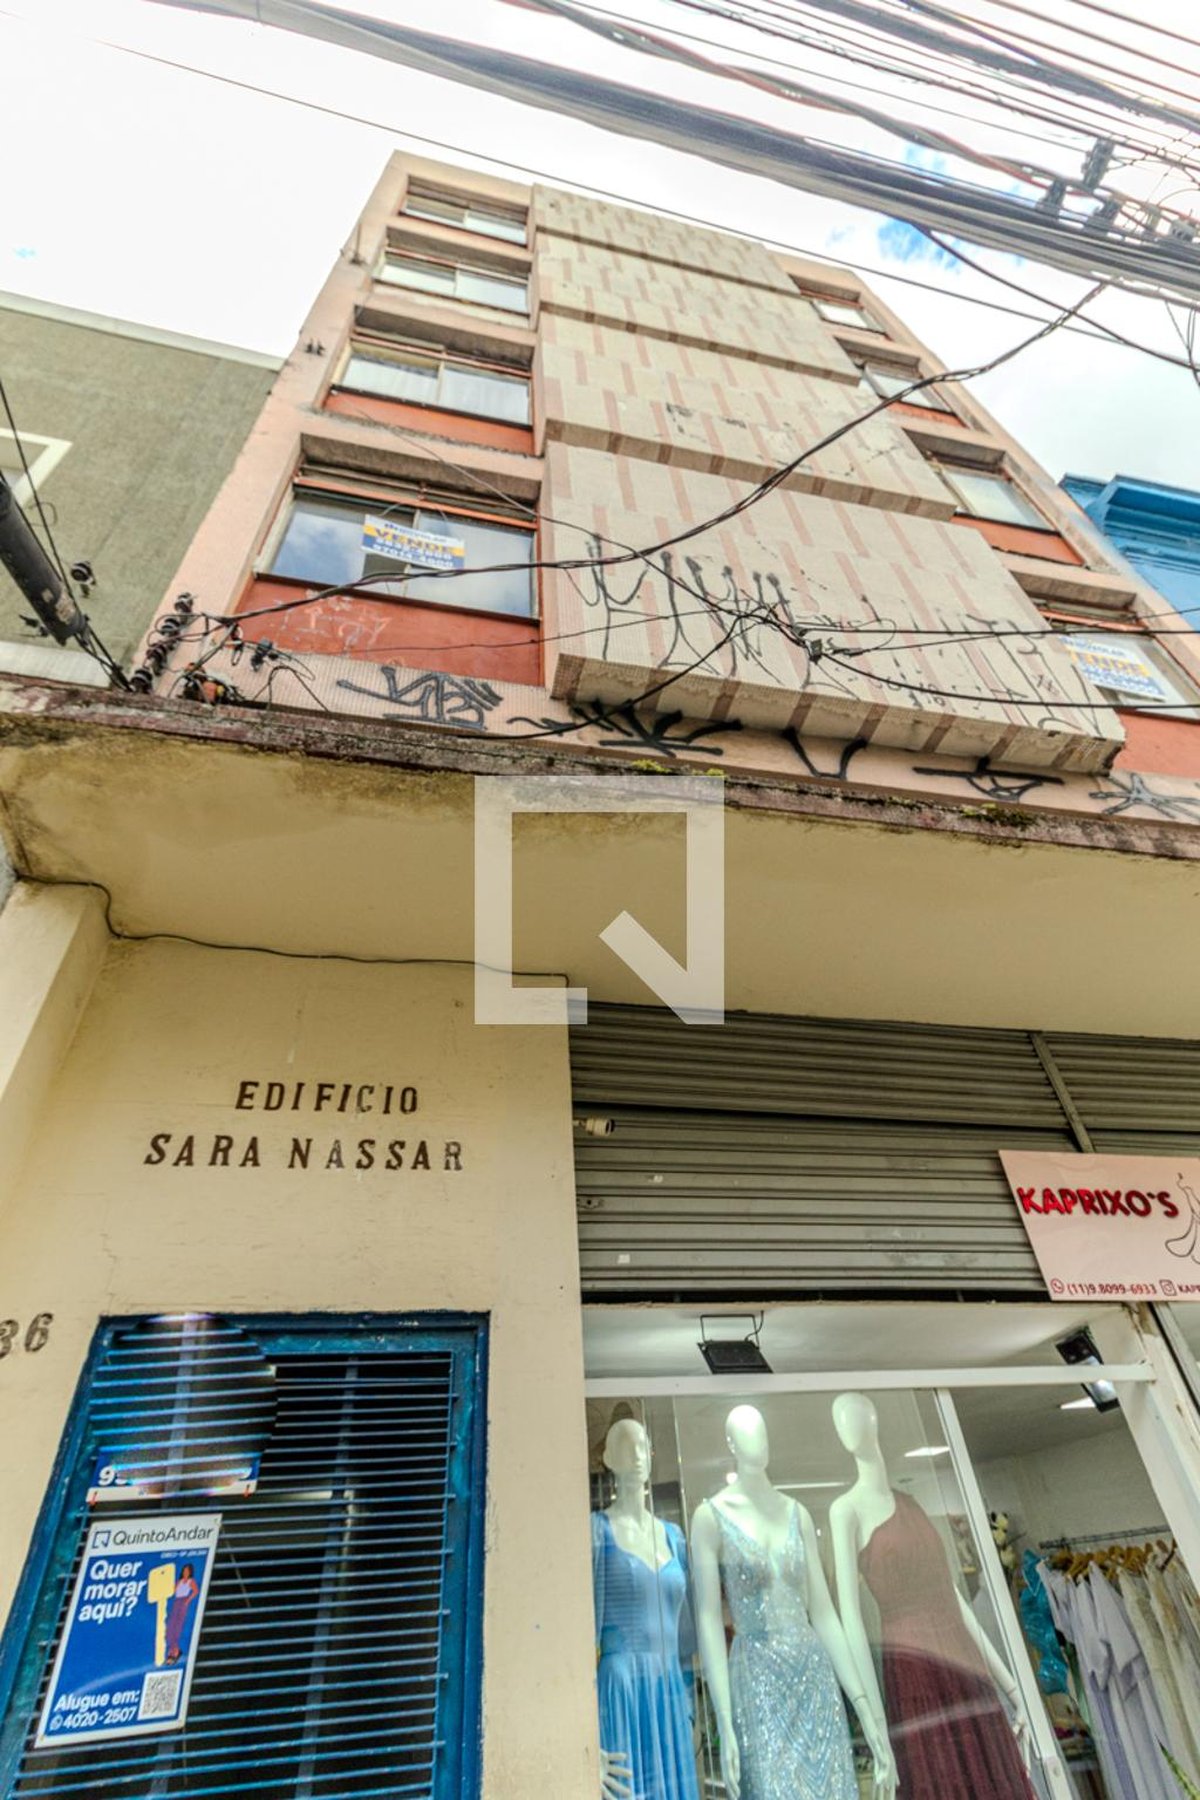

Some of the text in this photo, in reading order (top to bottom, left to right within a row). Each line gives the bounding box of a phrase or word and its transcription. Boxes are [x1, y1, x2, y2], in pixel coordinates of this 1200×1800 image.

[235, 1080, 419, 1115] EDIFICIO
[144, 1133, 464, 1172] SARA NASSAR
[112, 1525, 215, 1547] QuintoAndar
[90, 1559, 143, 1580] Quer
[83, 1579, 147, 1601] morar
[78, 1596, 138, 1624] aqui?
[53, 1690, 141, 1713] Alugue em:
